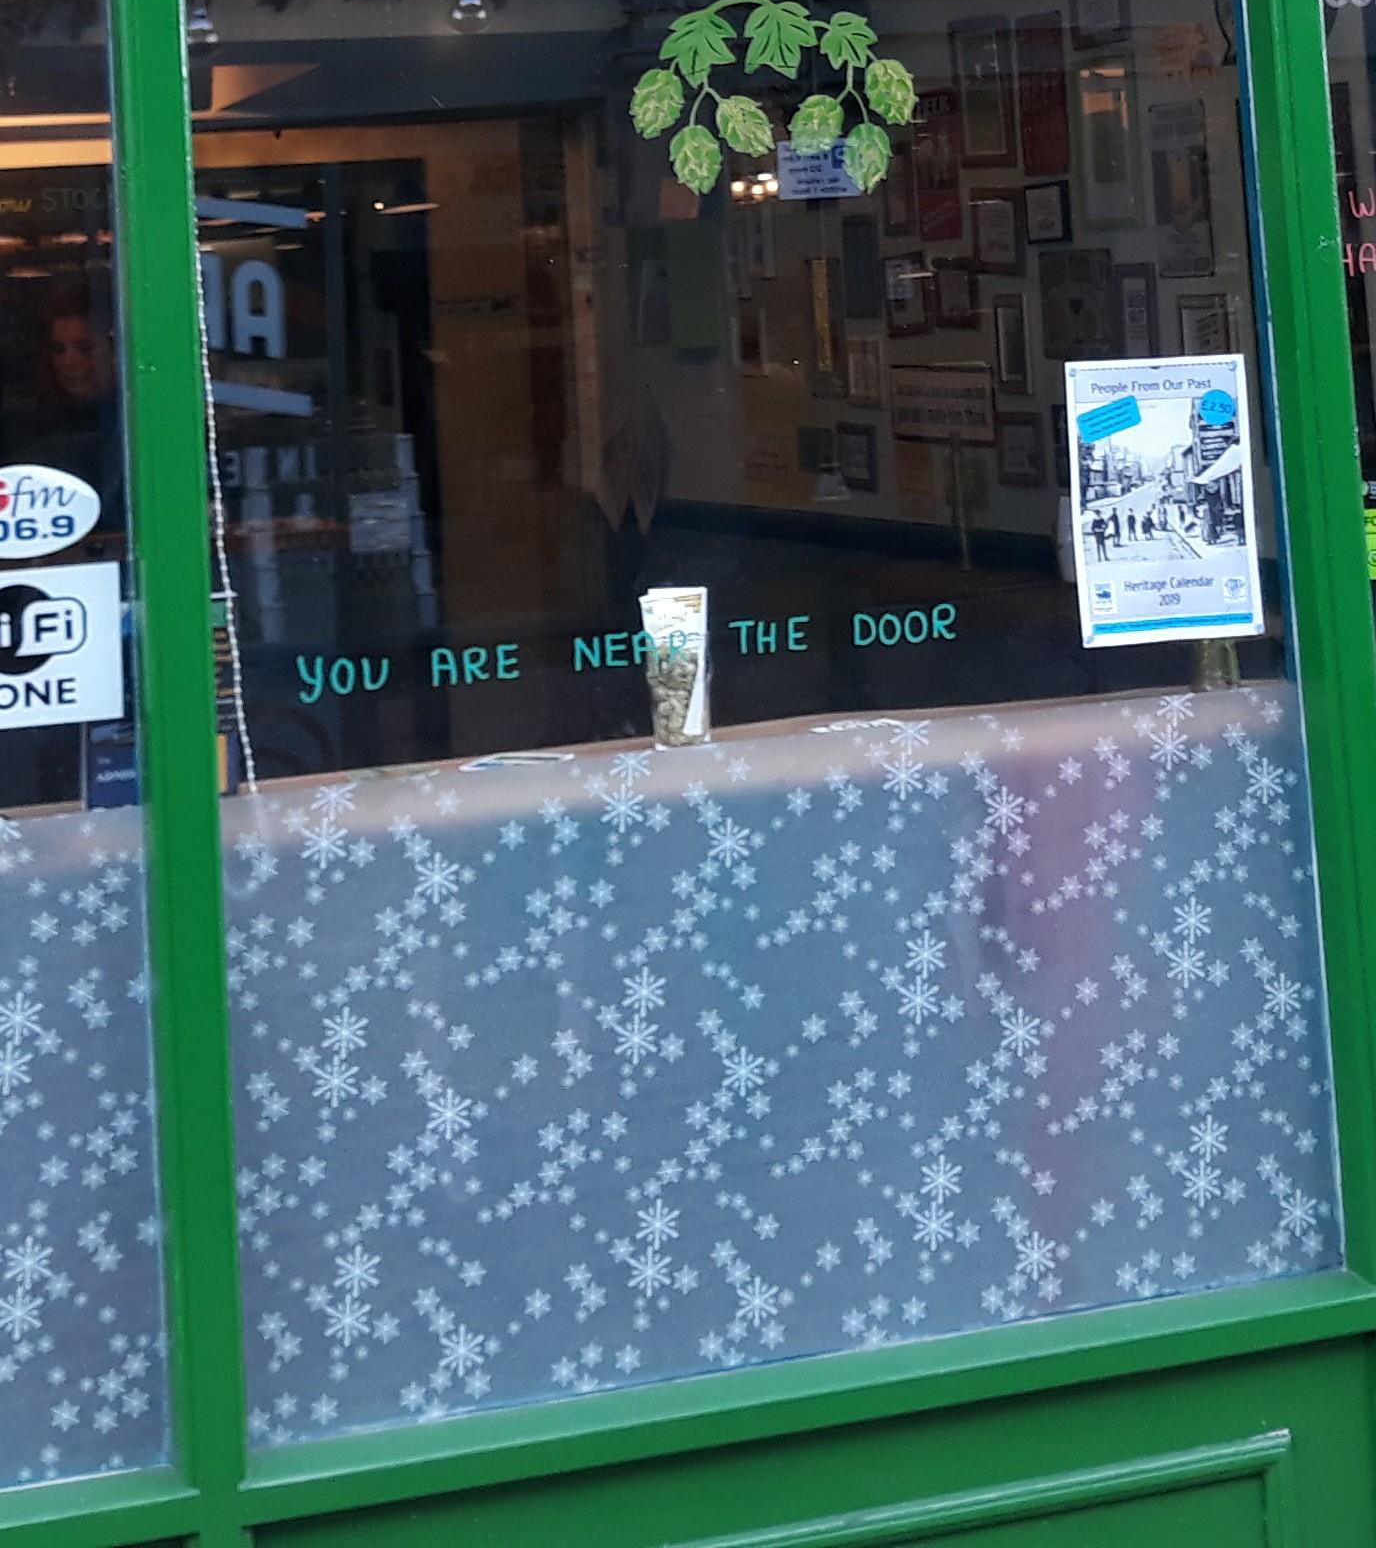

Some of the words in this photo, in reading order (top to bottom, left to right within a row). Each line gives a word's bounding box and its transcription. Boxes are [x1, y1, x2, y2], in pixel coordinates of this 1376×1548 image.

[1091, 382, 1128, 395] People
[1131, 381, 1160, 392] From
[1163, 379, 1184, 390] Our
[1188, 378, 1212, 389] Past
[1201, 400, 1232, 414] £2.50
[1124, 579, 1167, 594] Heritage
[1170, 576, 1214, 590] Calendar
[297, 655, 390, 705] YOU
[431, 643, 520, 688] ARE
[573, 630, 692, 672] NEAR
[729, 616, 811, 655] THE
[852, 603, 957, 648] DOOR
